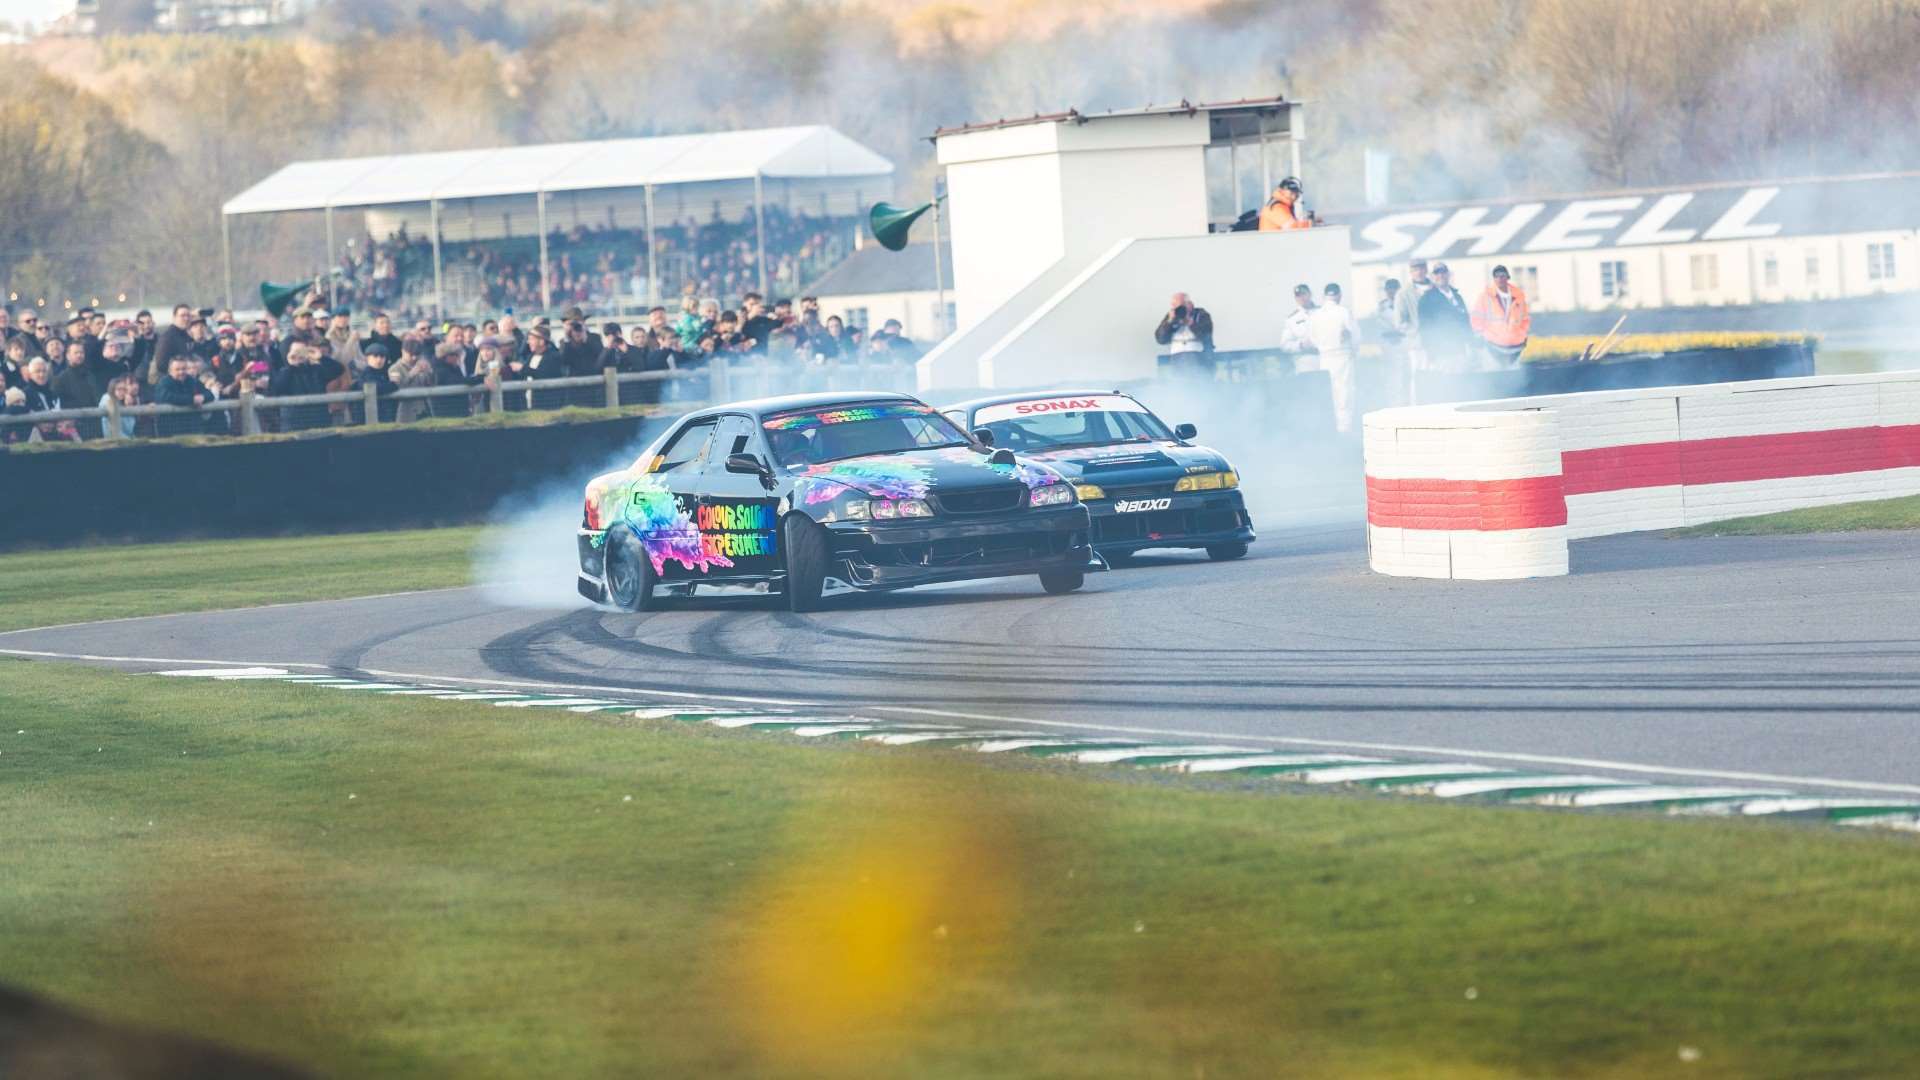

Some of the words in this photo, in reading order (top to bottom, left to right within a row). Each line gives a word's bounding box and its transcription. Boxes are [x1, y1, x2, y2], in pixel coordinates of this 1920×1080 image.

[1352, 187, 1782, 259] SHELL
[1015, 399, 1101, 414] SONAX
[1127, 498, 1171, 512] BOXO
[698, 504, 736, 530] COLOUR
